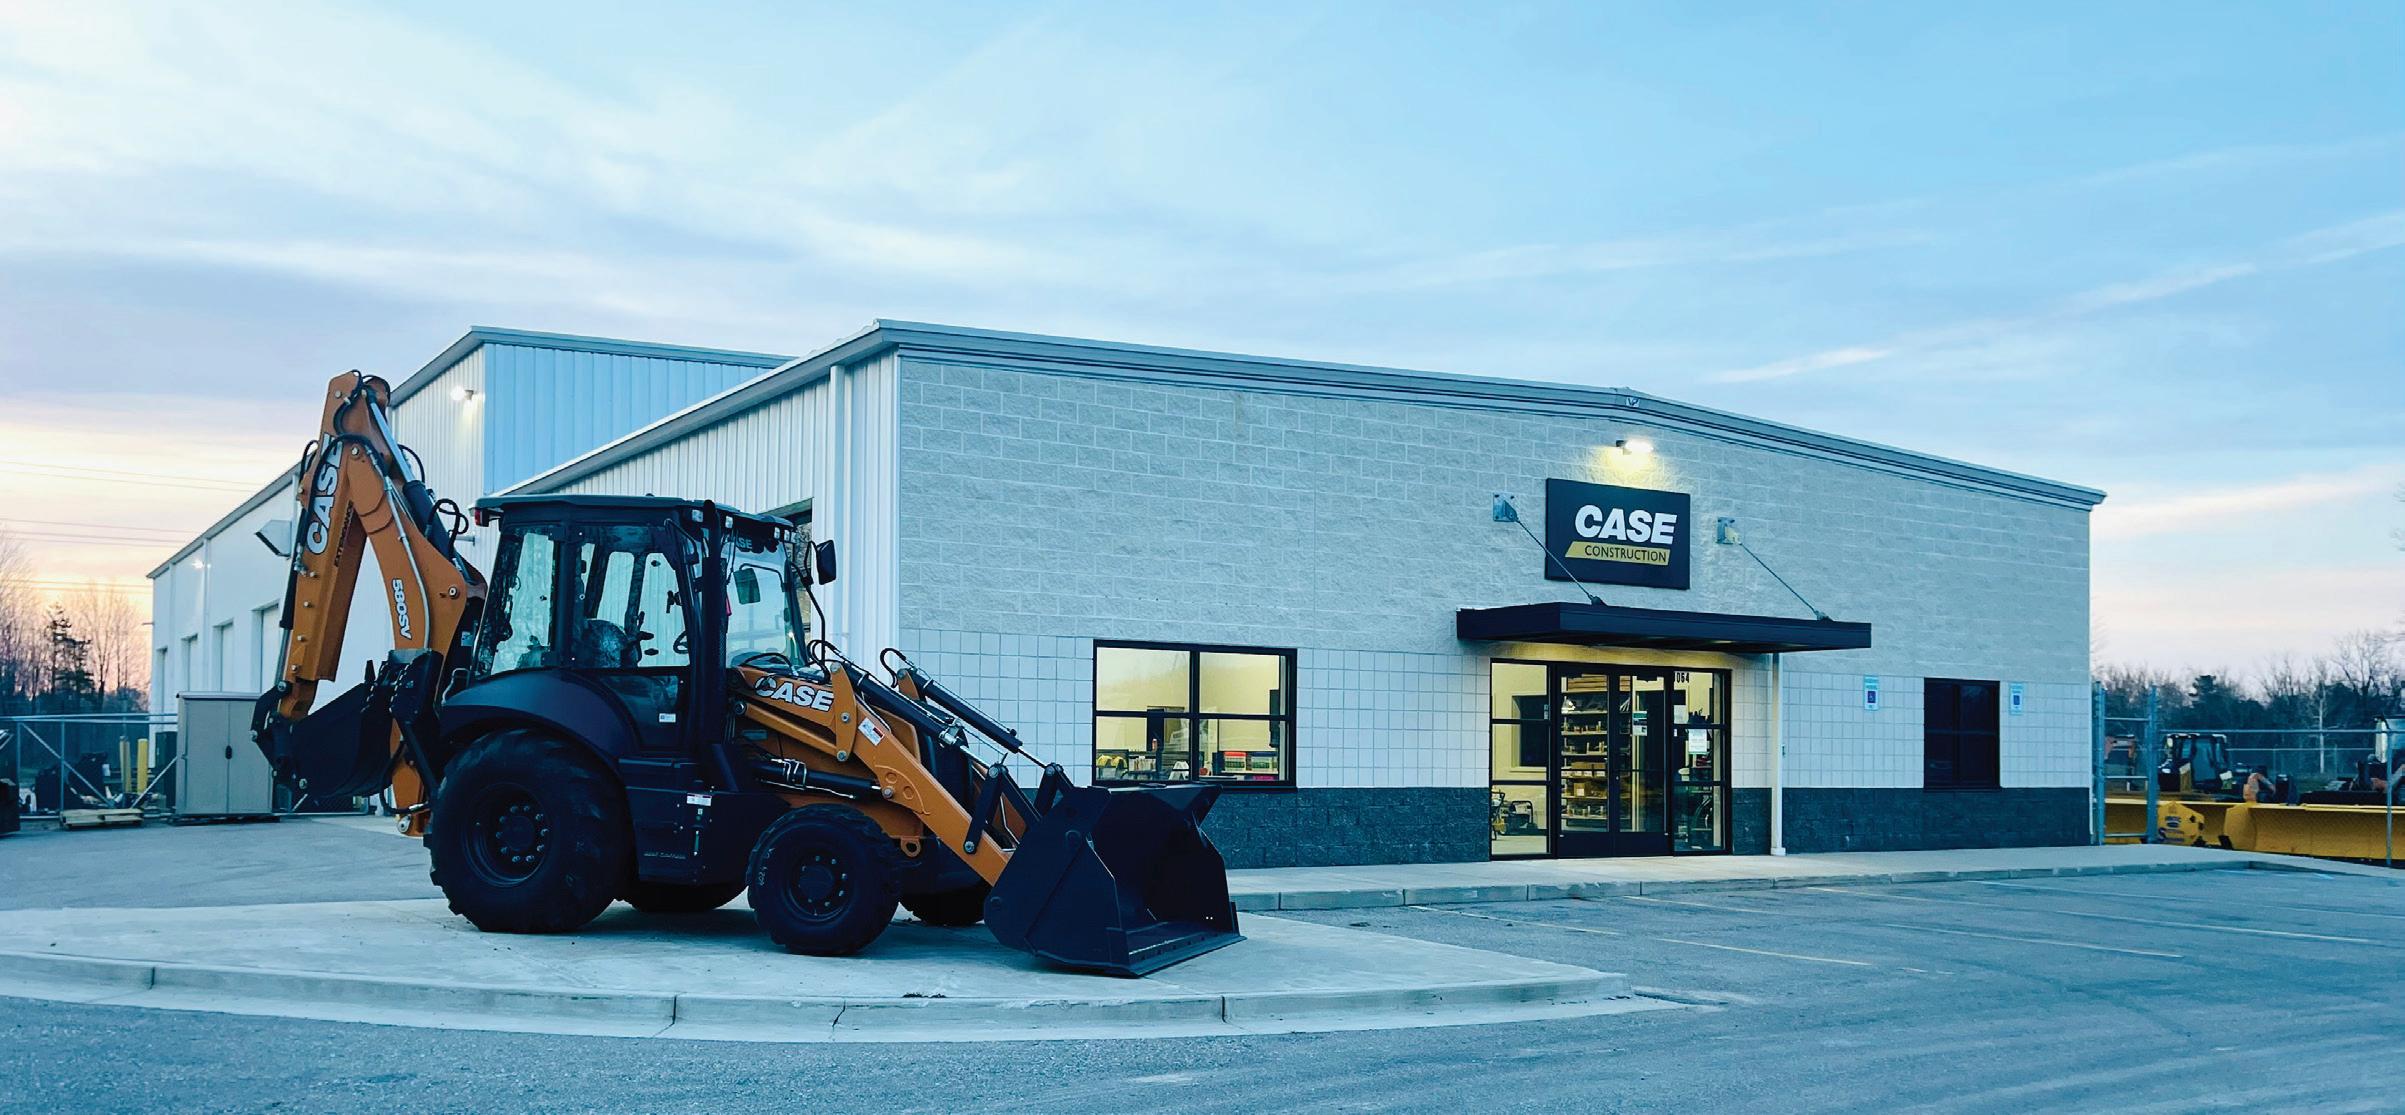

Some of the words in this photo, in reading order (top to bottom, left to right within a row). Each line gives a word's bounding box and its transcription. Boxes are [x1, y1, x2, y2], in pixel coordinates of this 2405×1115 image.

[306, 432, 344, 556] CASE
[1574, 504, 1678, 545] CASE
[1584, 545, 1667, 563] CONSTRUCTION
[391, 578, 412, 641] 580SV
[754, 676, 835, 712] CASE
